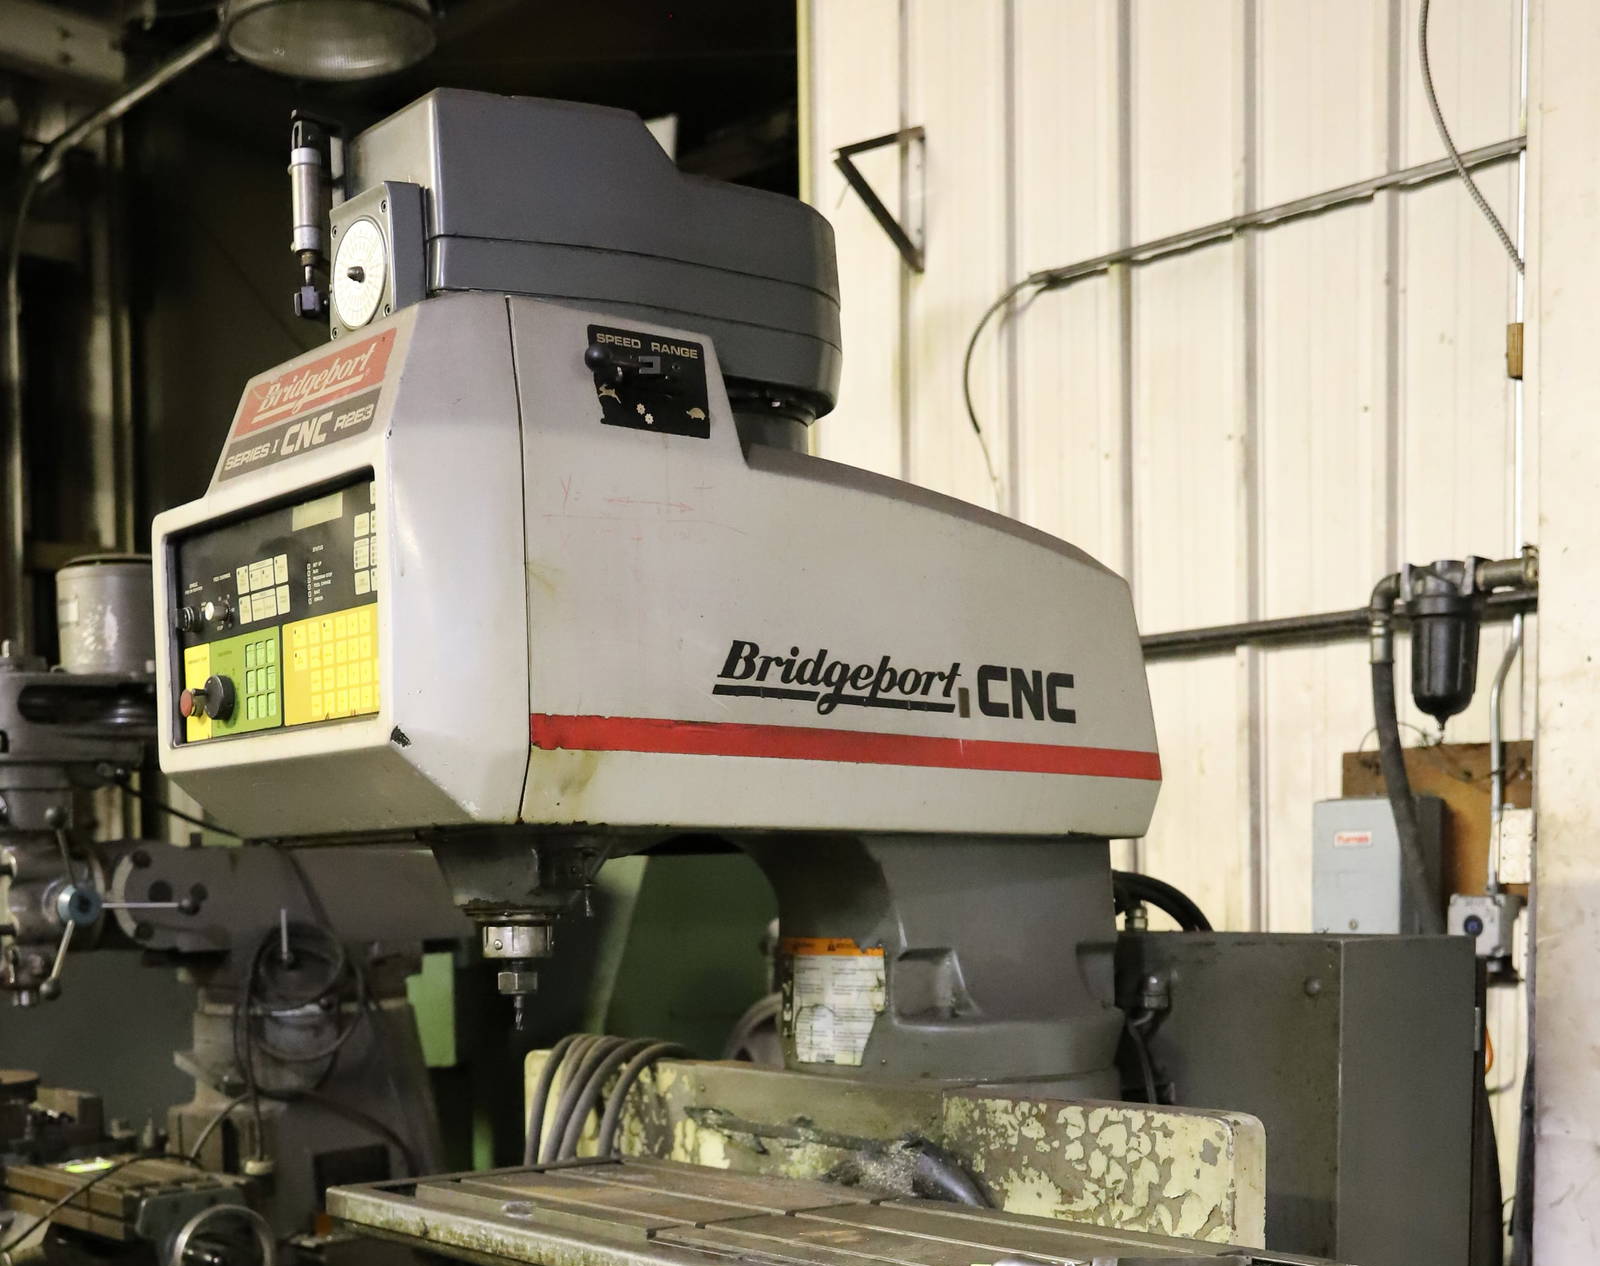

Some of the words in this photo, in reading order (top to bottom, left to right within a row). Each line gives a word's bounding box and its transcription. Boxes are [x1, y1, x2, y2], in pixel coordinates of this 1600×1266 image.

[257, 342, 378, 416] Bridgeport
[596, 332, 641, 349] SPEED
[650, 341, 699, 359] RANGE
[224, 443, 272, 471] SERIES
[271, 438, 281, 454] I
[280, 411, 333, 456] CNC
[333, 403, 375, 433] R2E3
[716, 639, 962, 715] Bridgeport
[976, 663, 1077, 725] CNC
